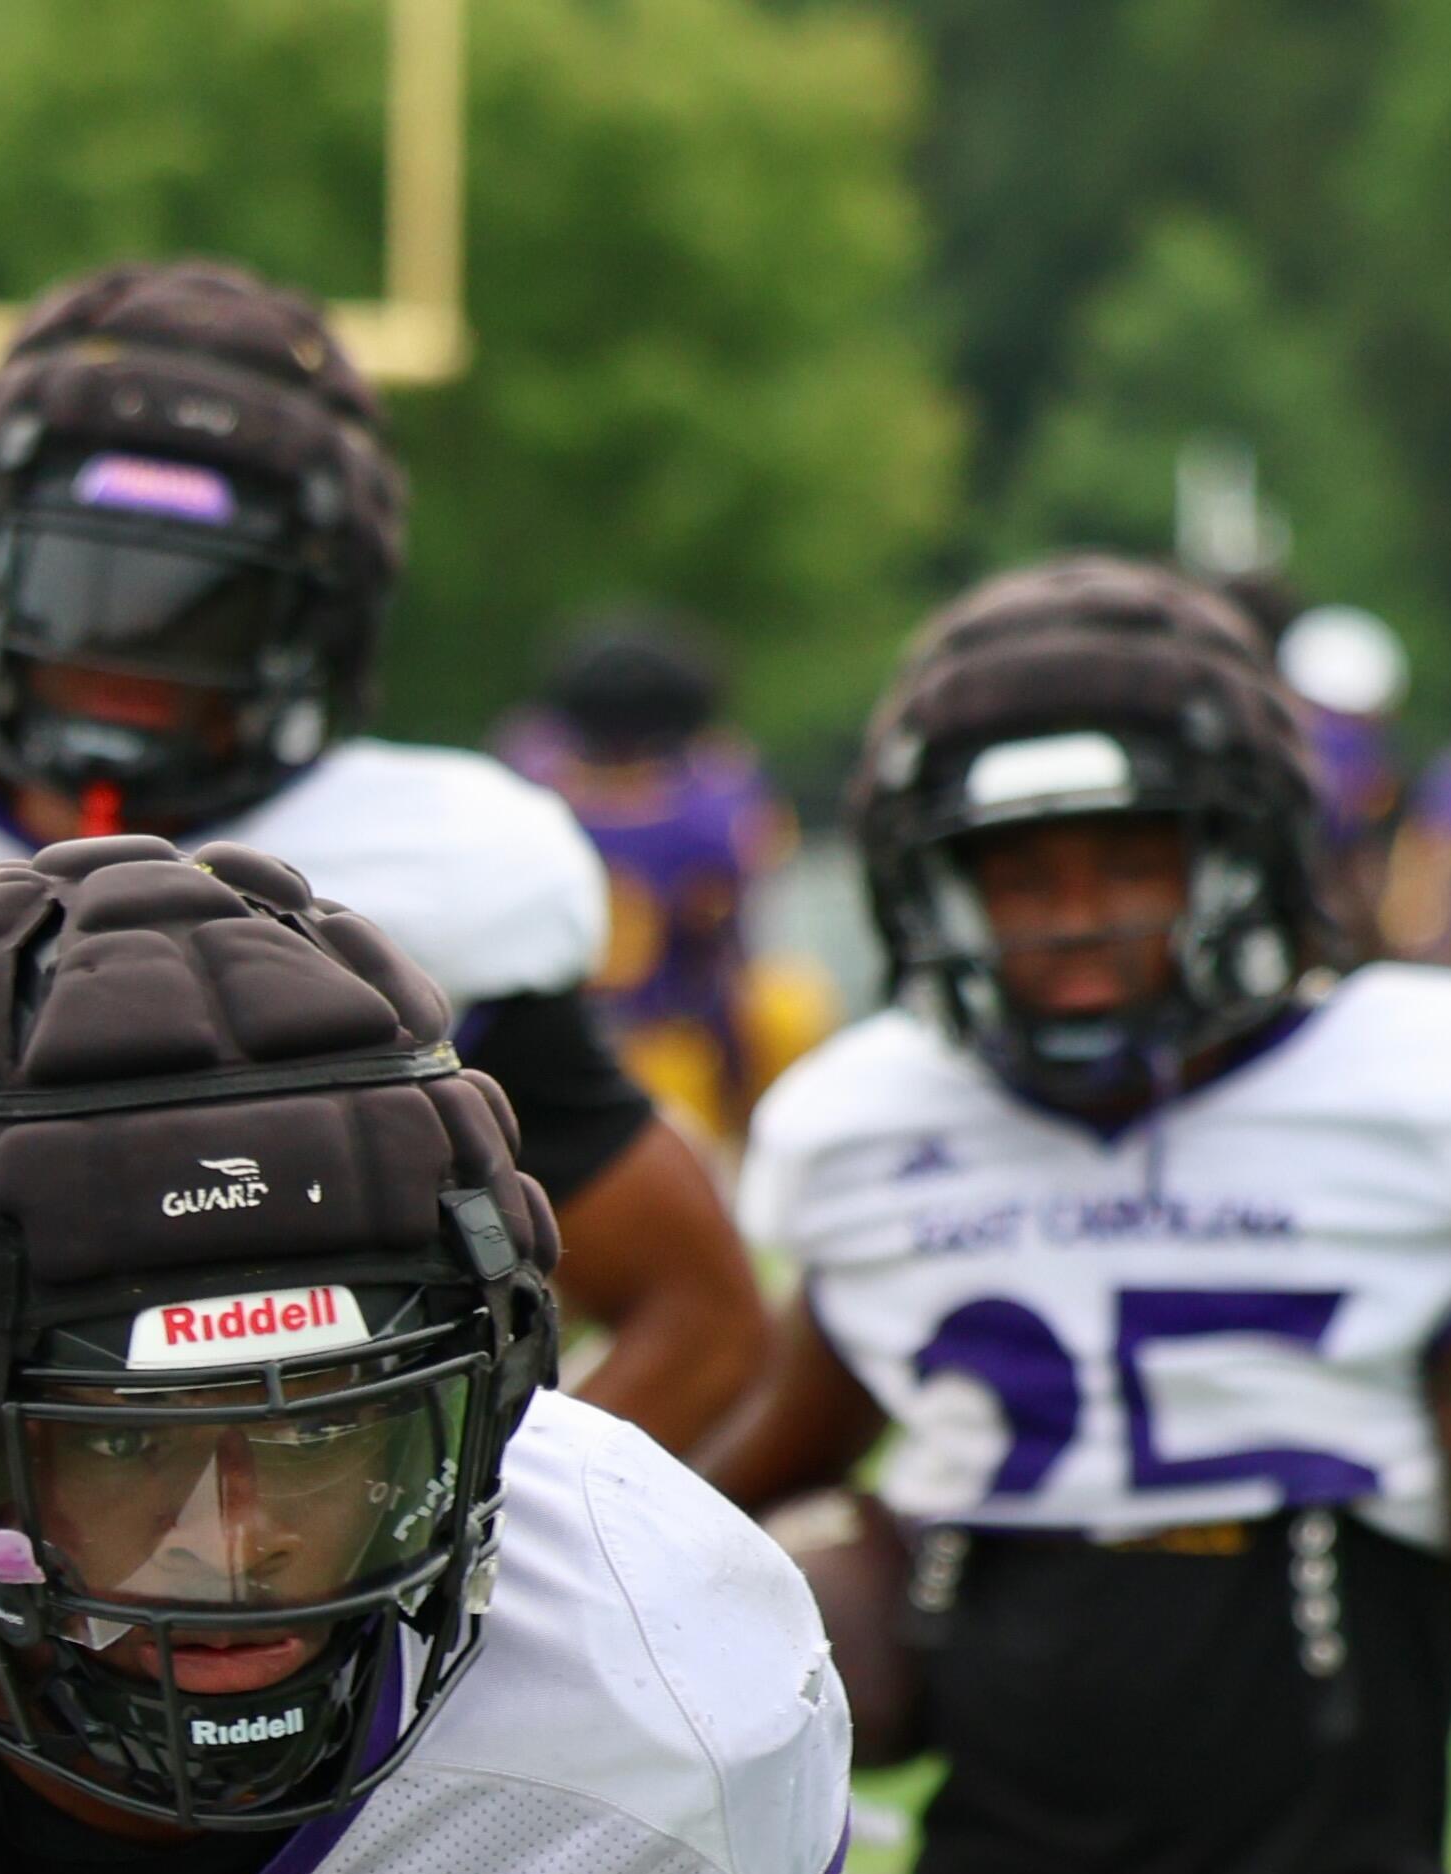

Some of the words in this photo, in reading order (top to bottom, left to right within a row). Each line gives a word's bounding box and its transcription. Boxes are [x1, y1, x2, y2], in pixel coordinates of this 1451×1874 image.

[160, 1286, 339, 1346] Riddell
[913, 1288, 1381, 1508] 25
[191, 1707, 305, 1745] Riddell
